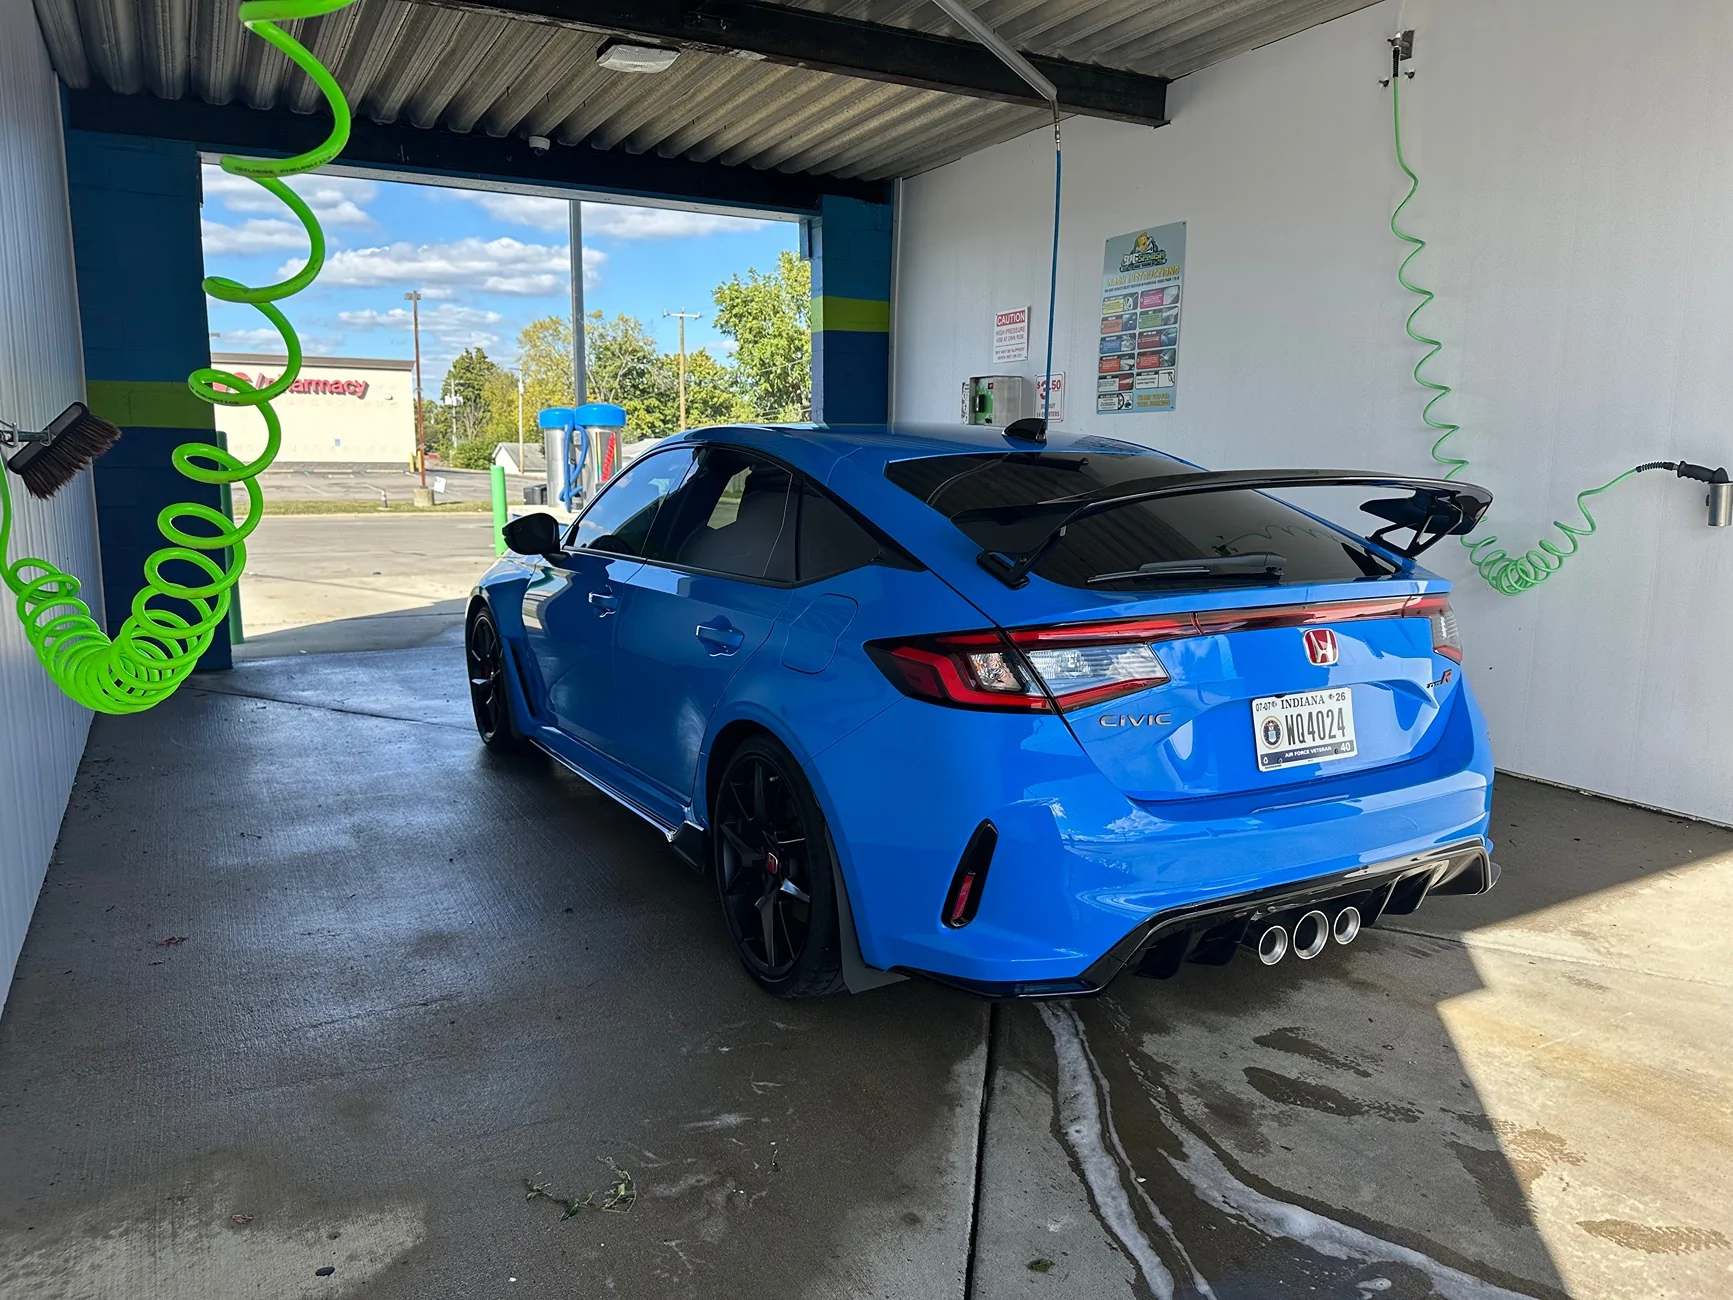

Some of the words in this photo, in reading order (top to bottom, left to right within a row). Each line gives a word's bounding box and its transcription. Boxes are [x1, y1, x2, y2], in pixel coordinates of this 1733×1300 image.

[997, 311, 1025, 325] CAUTION
[996, 329, 1004, 337] HIGH
[1005, 326, 1025, 335] PRESSURE
[1281, 695, 1325, 709] INDIANA
[1336, 692, 1346, 701] 26
[1099, 713, 1172, 727] CIVIC
[1285, 707, 1346, 746] WQ4024
[1310, 746, 1332, 755] VETERAN
[1340, 742, 1351, 752] 40
